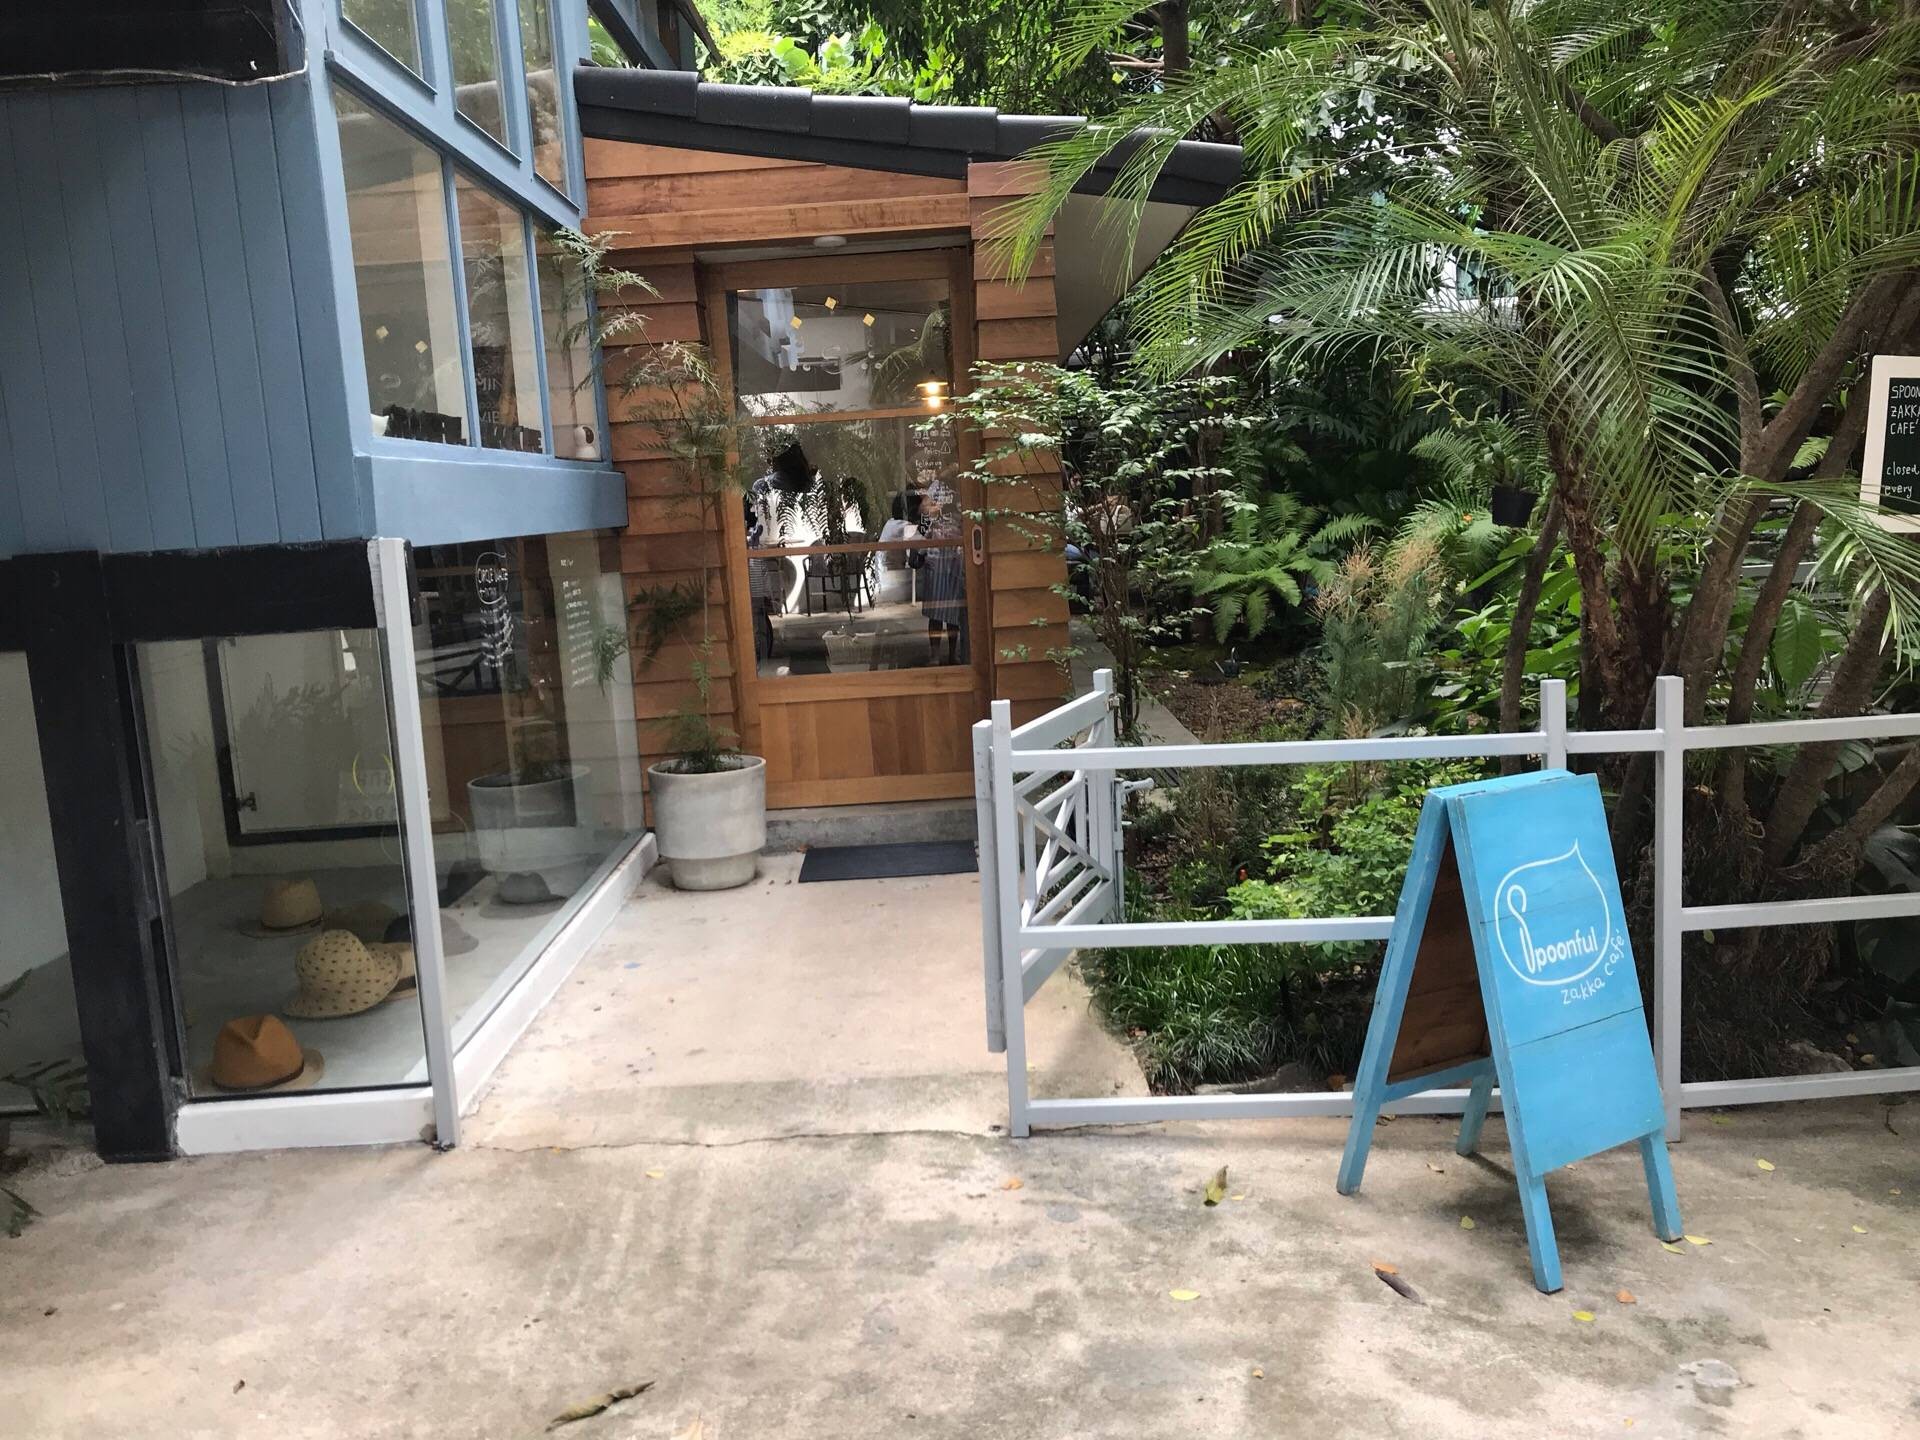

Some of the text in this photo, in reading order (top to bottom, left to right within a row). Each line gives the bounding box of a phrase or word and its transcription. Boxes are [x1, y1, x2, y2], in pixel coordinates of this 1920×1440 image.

[1886, 461, 1920, 476] closed
[1884, 485, 1912, 499] every
[1507, 884, 1598, 974] Spoonful
